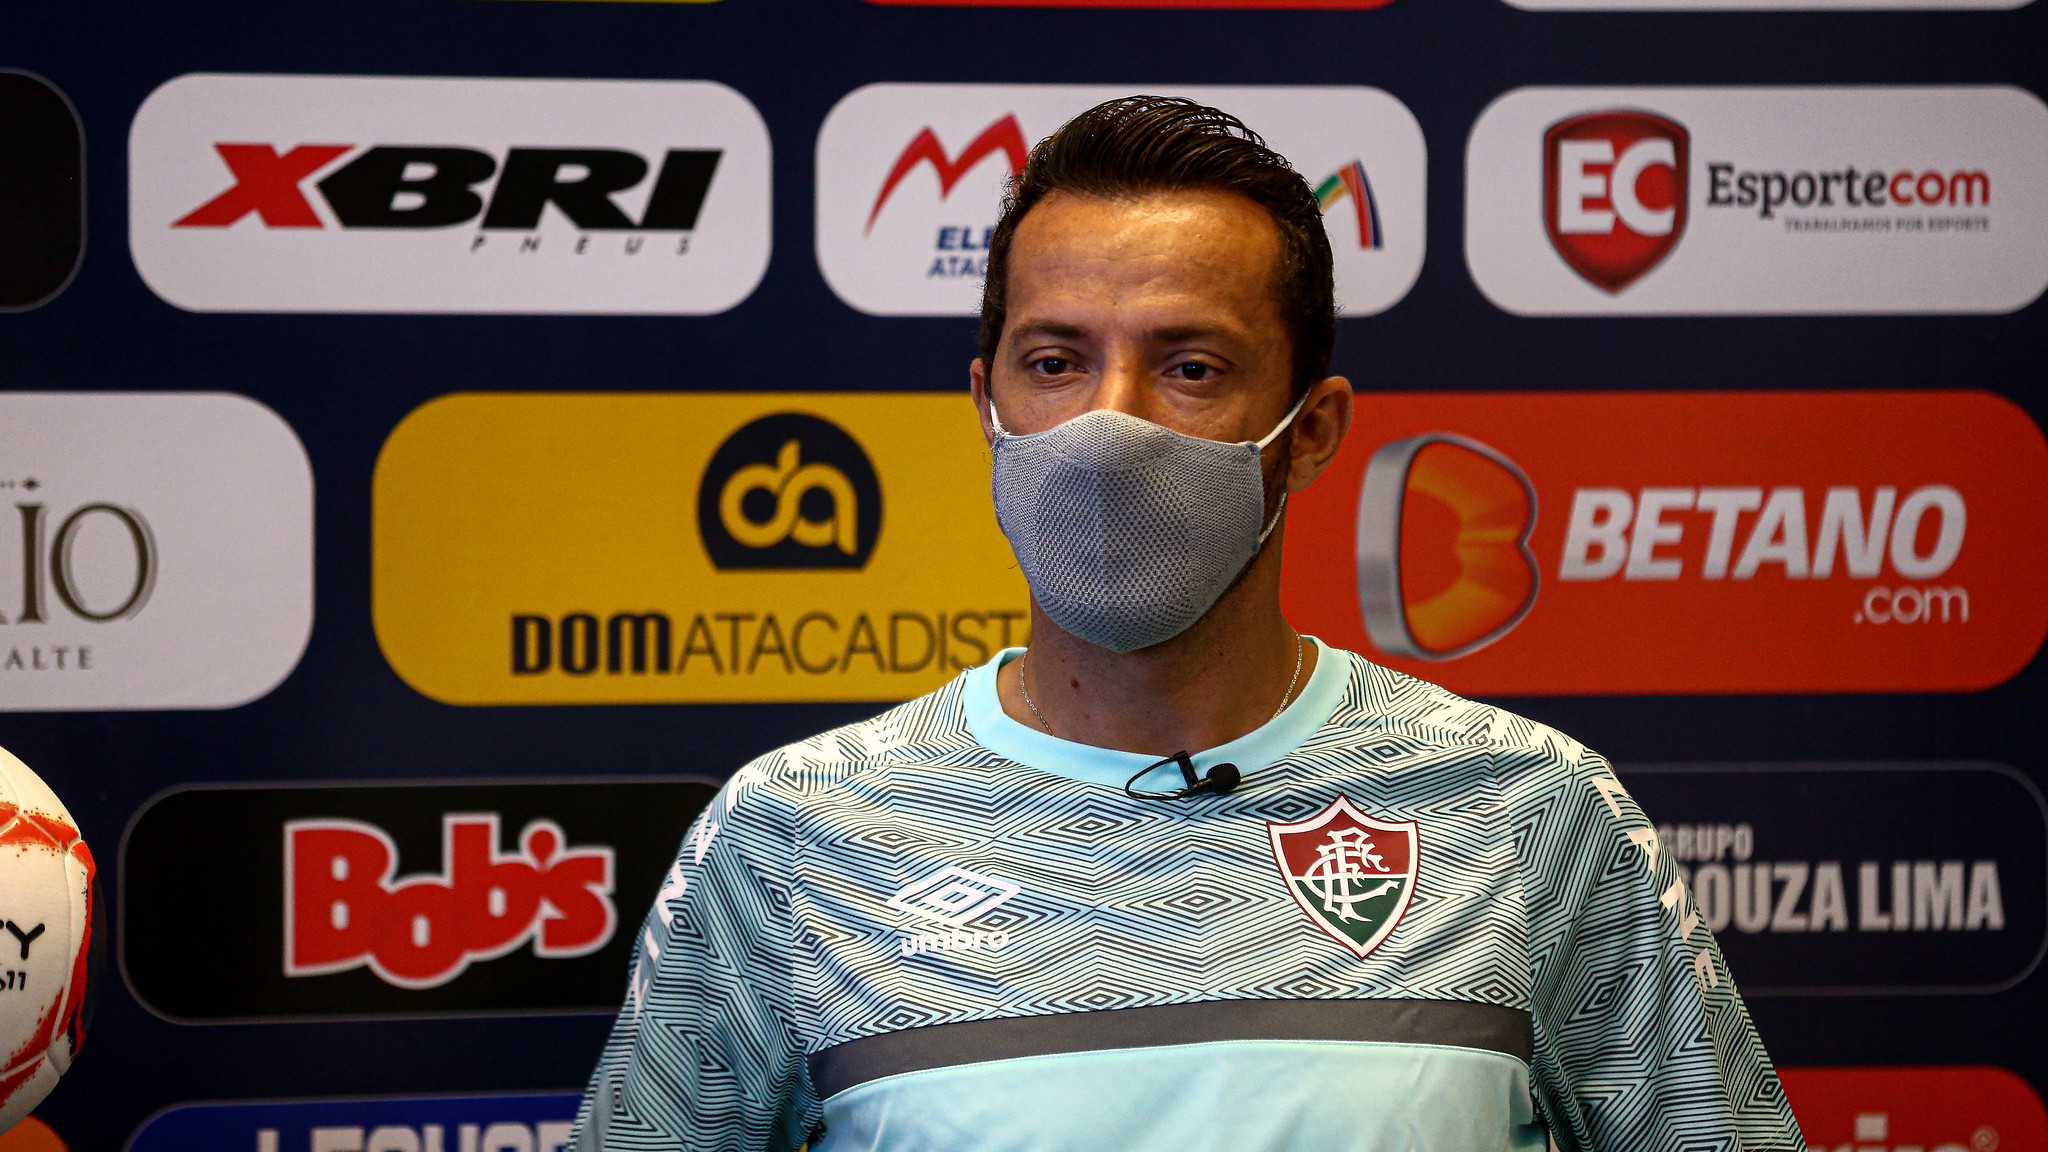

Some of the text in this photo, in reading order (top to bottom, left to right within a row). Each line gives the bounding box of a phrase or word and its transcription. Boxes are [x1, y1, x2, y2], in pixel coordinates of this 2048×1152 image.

[171, 142, 725, 231] XBRI
[1557, 136, 1678, 238] EC
[1707, 163, 1991, 218] Esportecom
[471, 234, 692, 256] PNEUS
[1928, 217, 1990, 233] ESPORTE
[0, 502, 159, 625] IO
[1559, 485, 1968, 582] BETANO
[1854, 586, 1969, 625] .com
[510, 611, 1031, 675] DOMATACADIST
[282, 811, 617, 988] Bob's
[1680, 860, 2005, 933] OUZA LIMA
[0, 920, 46, 960] Y
[901, 928, 1009, 956] umbro
